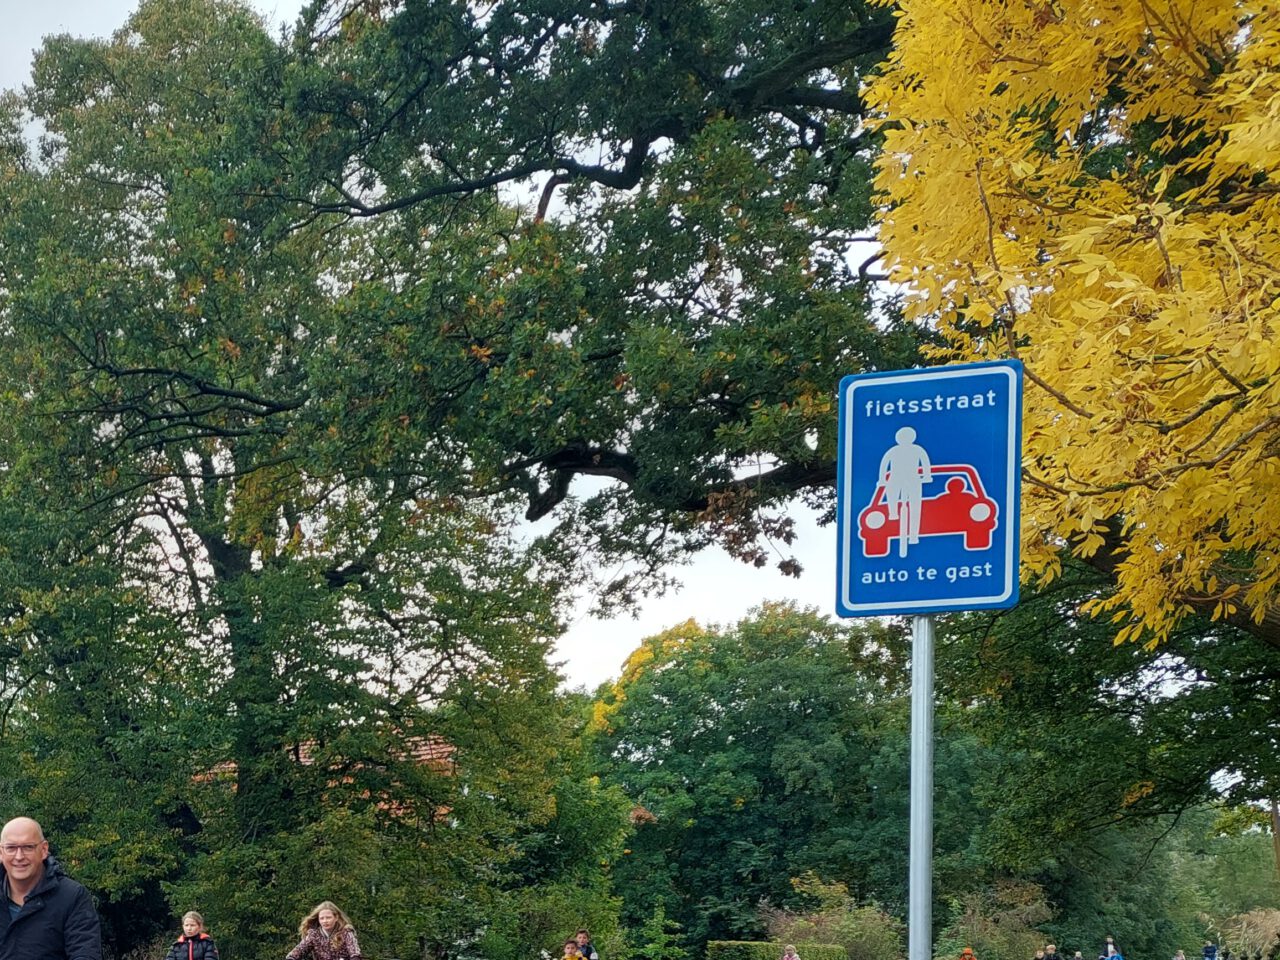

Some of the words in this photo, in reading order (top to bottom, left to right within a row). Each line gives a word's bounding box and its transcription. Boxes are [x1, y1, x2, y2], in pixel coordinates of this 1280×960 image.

[865, 389, 996, 417] fietsstraat
[861, 568, 909, 584] auto
[916, 566, 938, 580] te
[945, 562, 993, 583] gast
